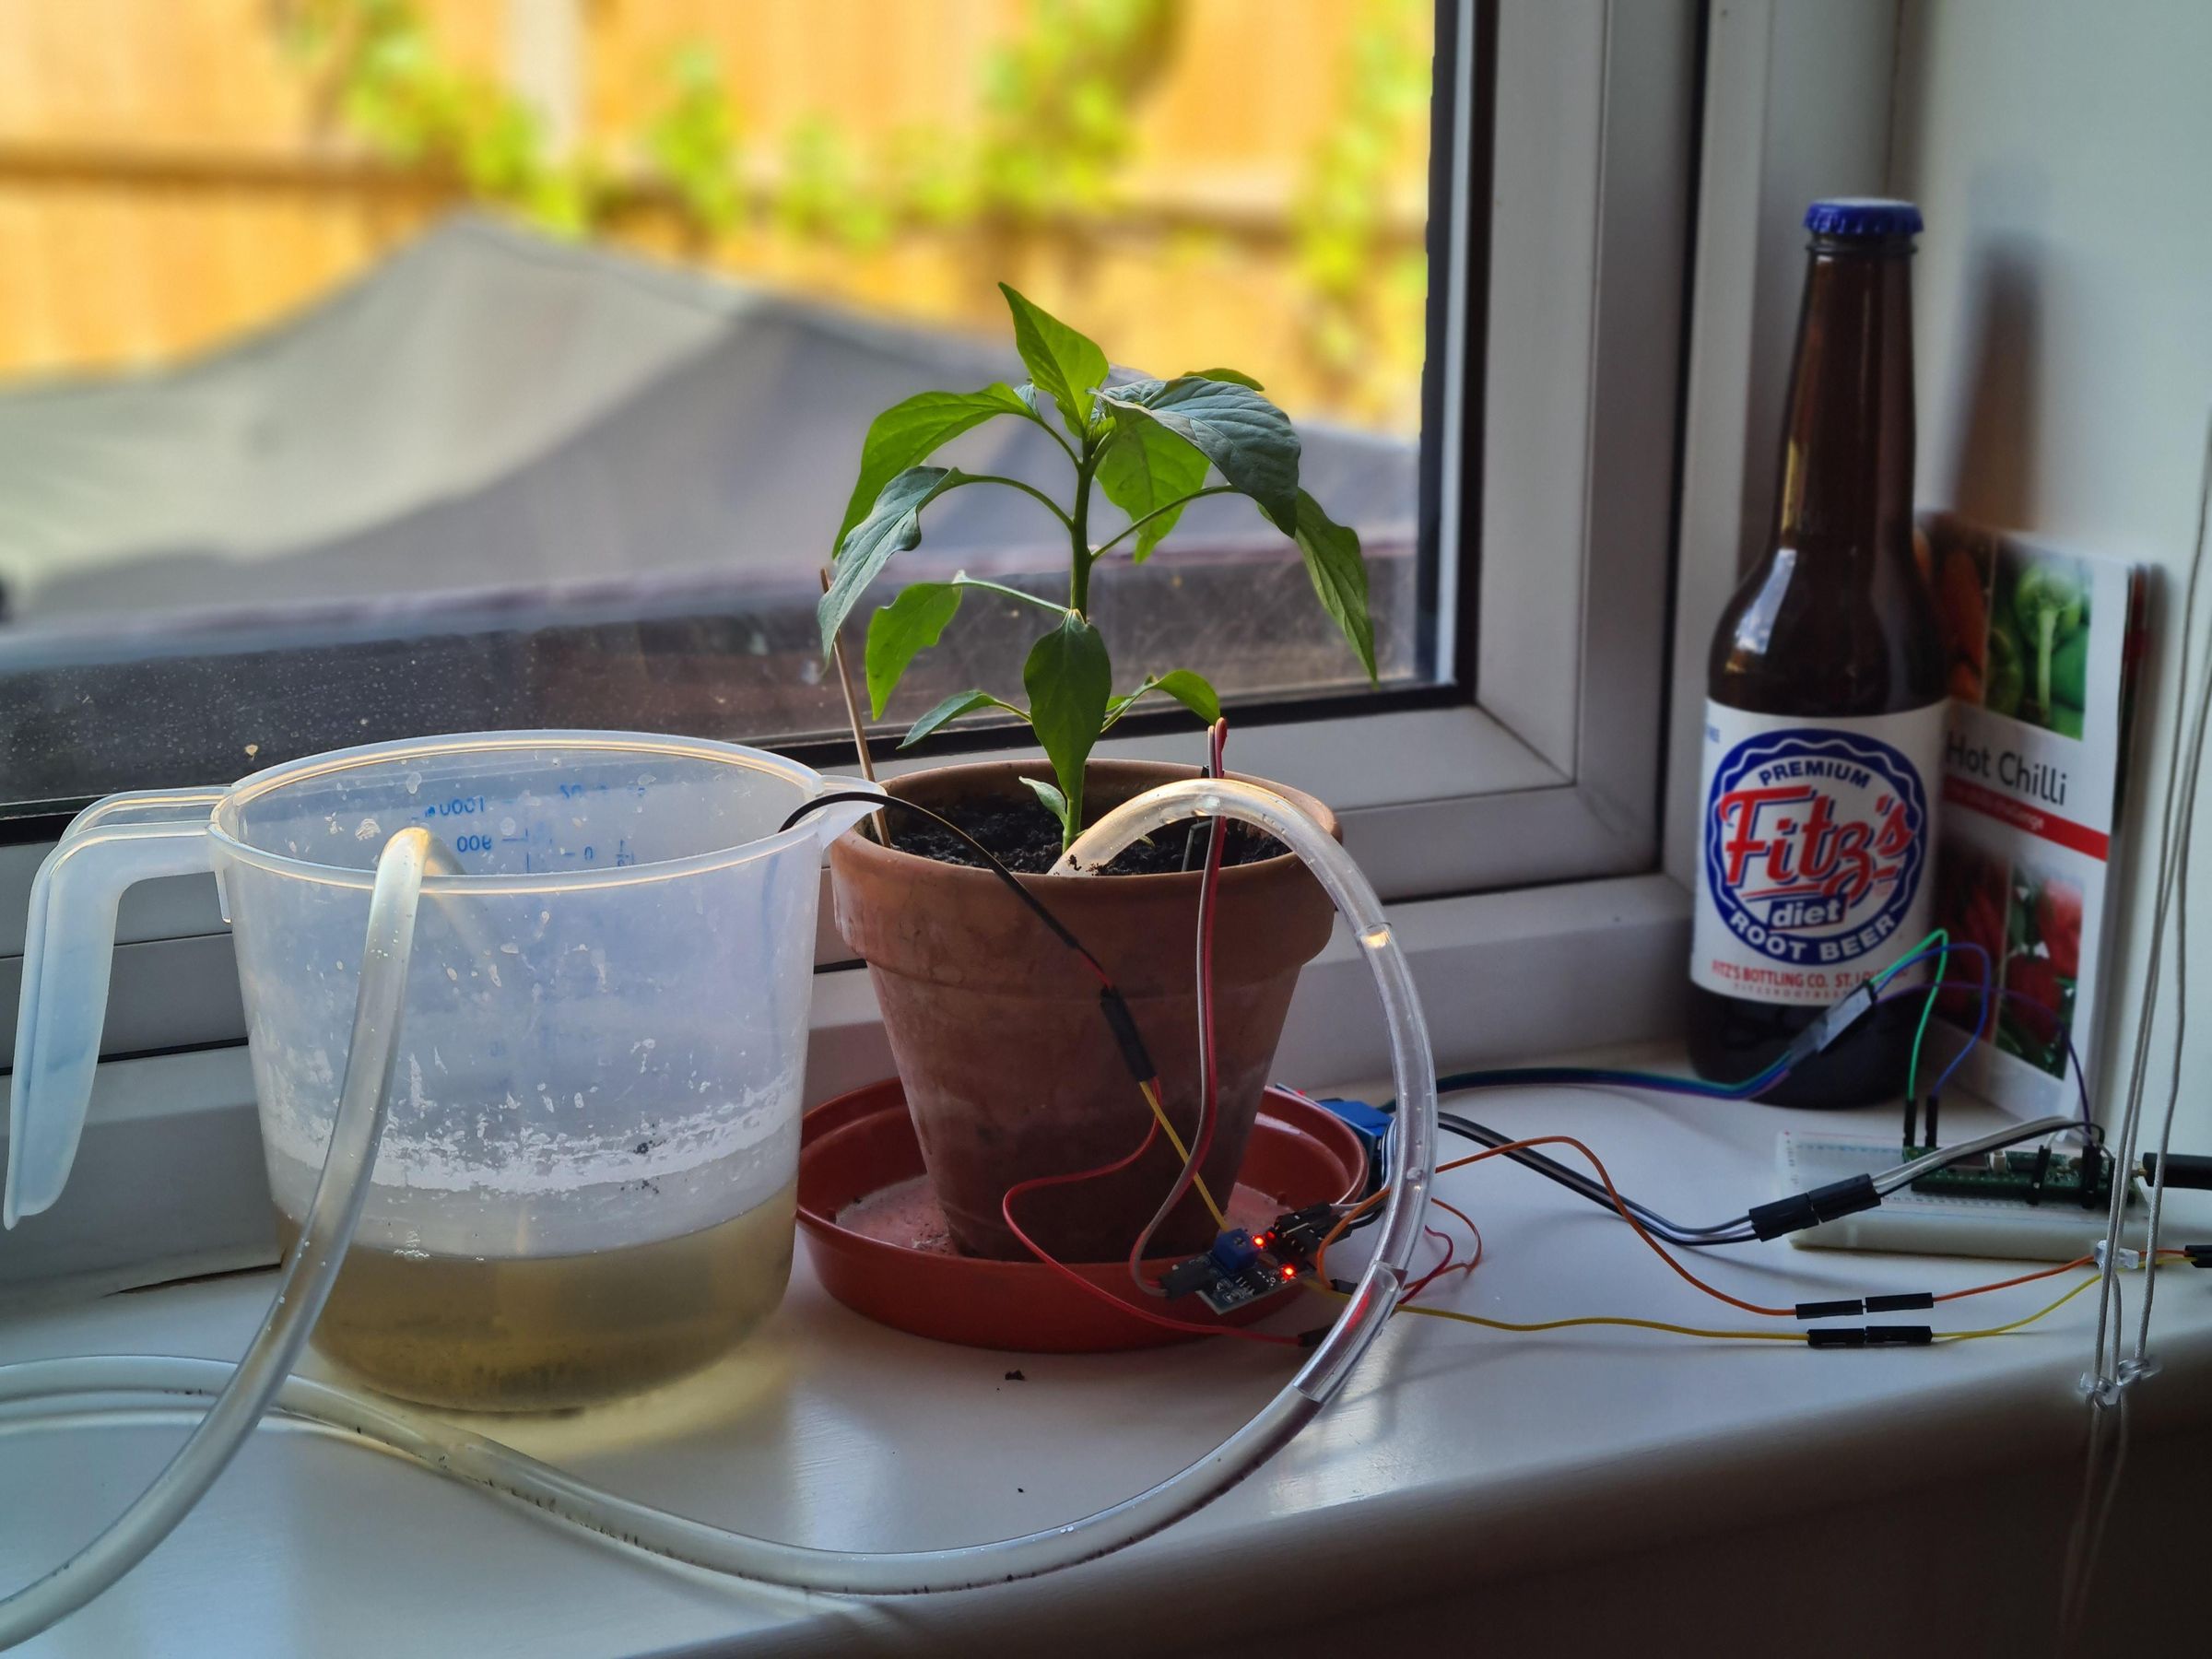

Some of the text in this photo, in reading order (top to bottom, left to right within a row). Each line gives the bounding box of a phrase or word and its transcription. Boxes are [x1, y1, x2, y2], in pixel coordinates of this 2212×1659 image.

[1758, 760, 1872, 789] PREMIUM
[1947, 732, 2067, 806] Hot Chilli
[1719, 784, 1915, 903] Fitz's
[1771, 898, 1842, 928] diet
[1729, 910, 1896, 961] ROOT BEER
[1742, 965, 1804, 988] BOTTLING
